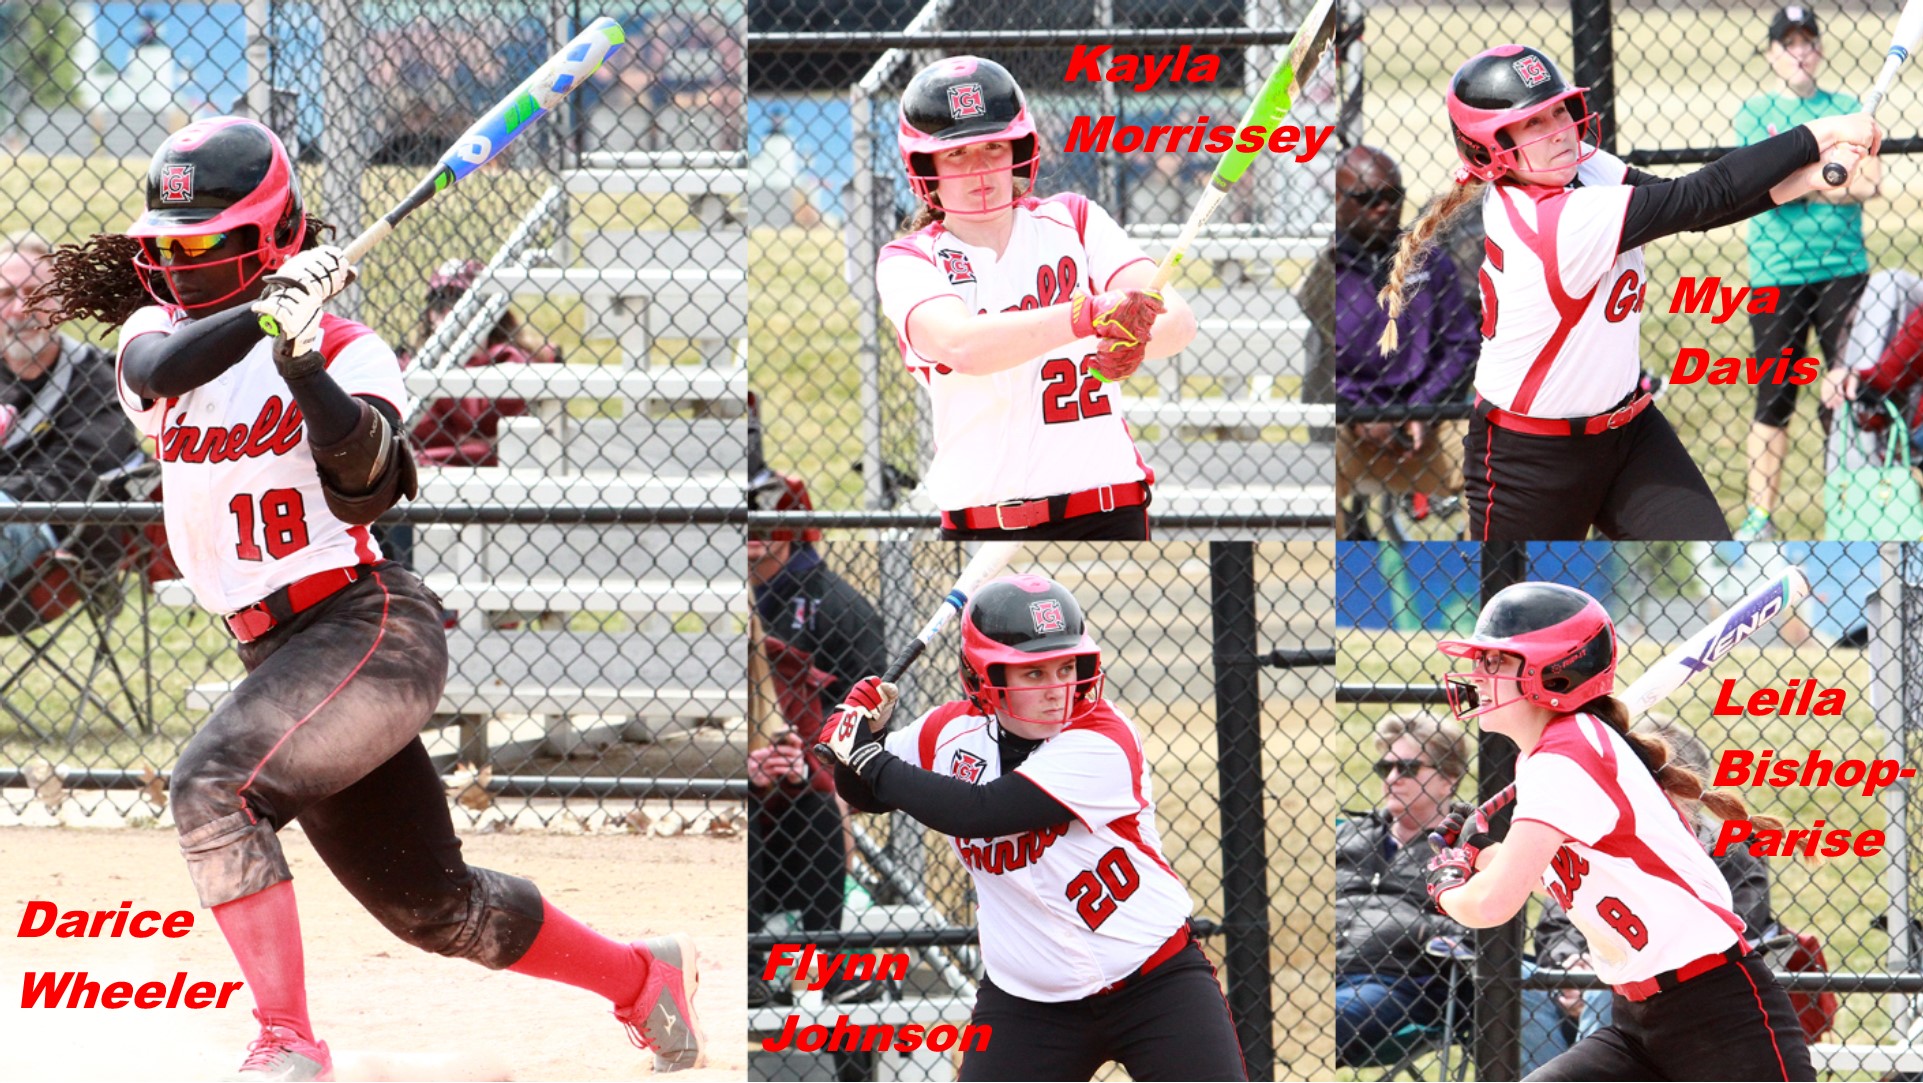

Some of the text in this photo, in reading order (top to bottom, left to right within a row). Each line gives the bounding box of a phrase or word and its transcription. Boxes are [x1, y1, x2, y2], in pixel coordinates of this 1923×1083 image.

[1041, 354, 1112, 424] 22
[162, 395, 303, 464] innell
[229, 488, 310, 561] 18
[1678, 596, 1783, 690] XENO
[1065, 846, 1140, 932] 20
[1596, 896, 1648, 952] 8
